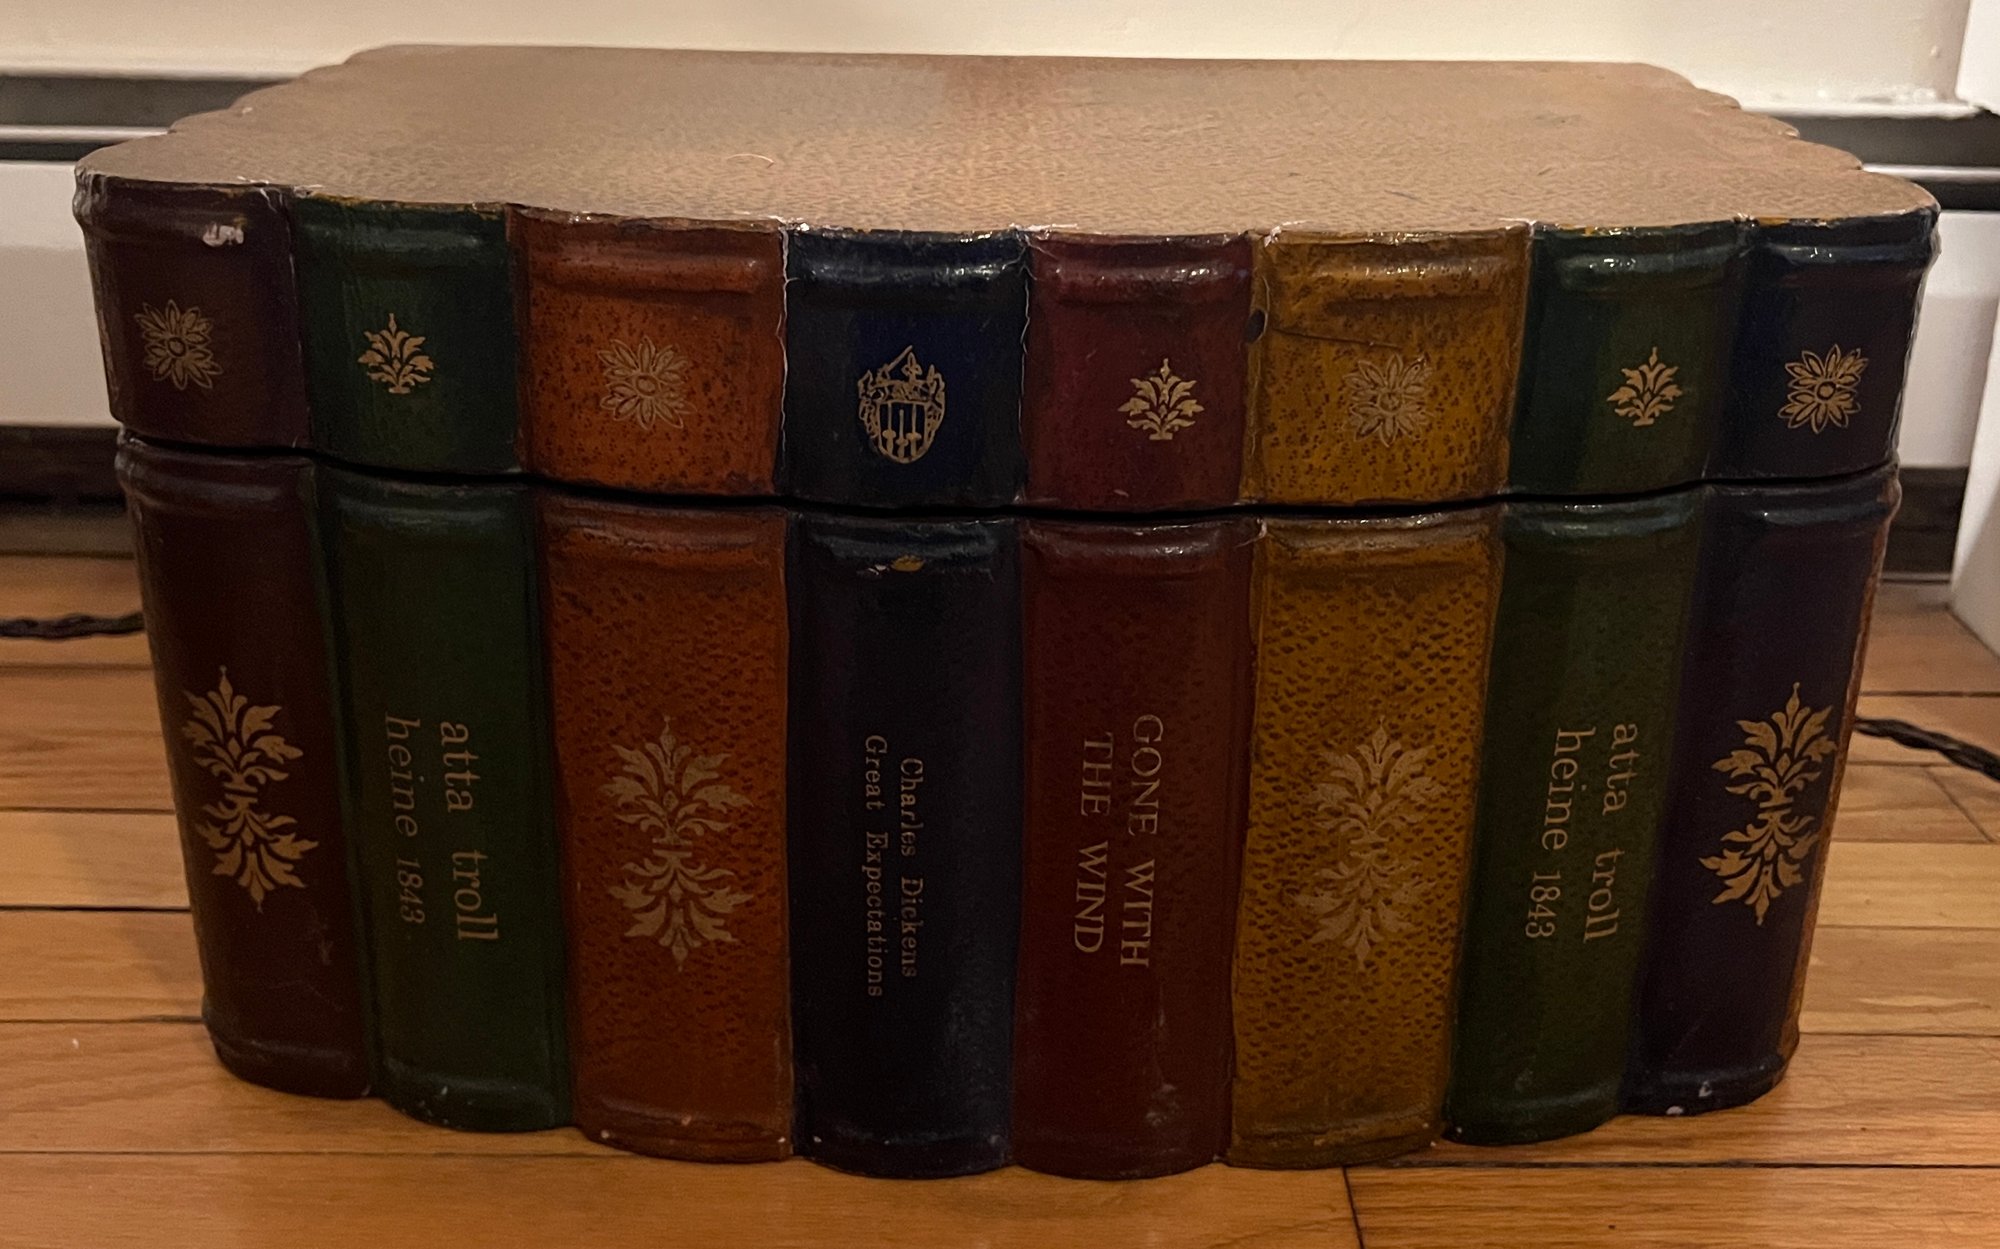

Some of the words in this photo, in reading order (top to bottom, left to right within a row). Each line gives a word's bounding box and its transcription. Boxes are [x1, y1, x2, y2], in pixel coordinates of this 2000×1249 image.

[385, 711, 424, 837] heine
[440, 721, 480, 813] atta
[865, 735, 888, 810] Great
[900, 757, 924, 857] Charles
[1081, 732, 1114, 816] THE
[1128, 714, 1164, 836] GONE
[1541, 726, 1596, 850] heine
[1602, 723, 1640, 816] atta
[397, 858, 425, 924] 1843
[452, 850, 499, 940] troll
[862, 831, 889, 996] Expectations
[901, 876, 924, 977] Dickens
[1074, 841, 1108, 953] WIND
[1120, 858, 1155, 968] WITH
[1525, 870, 1561, 938] 1843
[1583, 848, 1625, 943] troll
